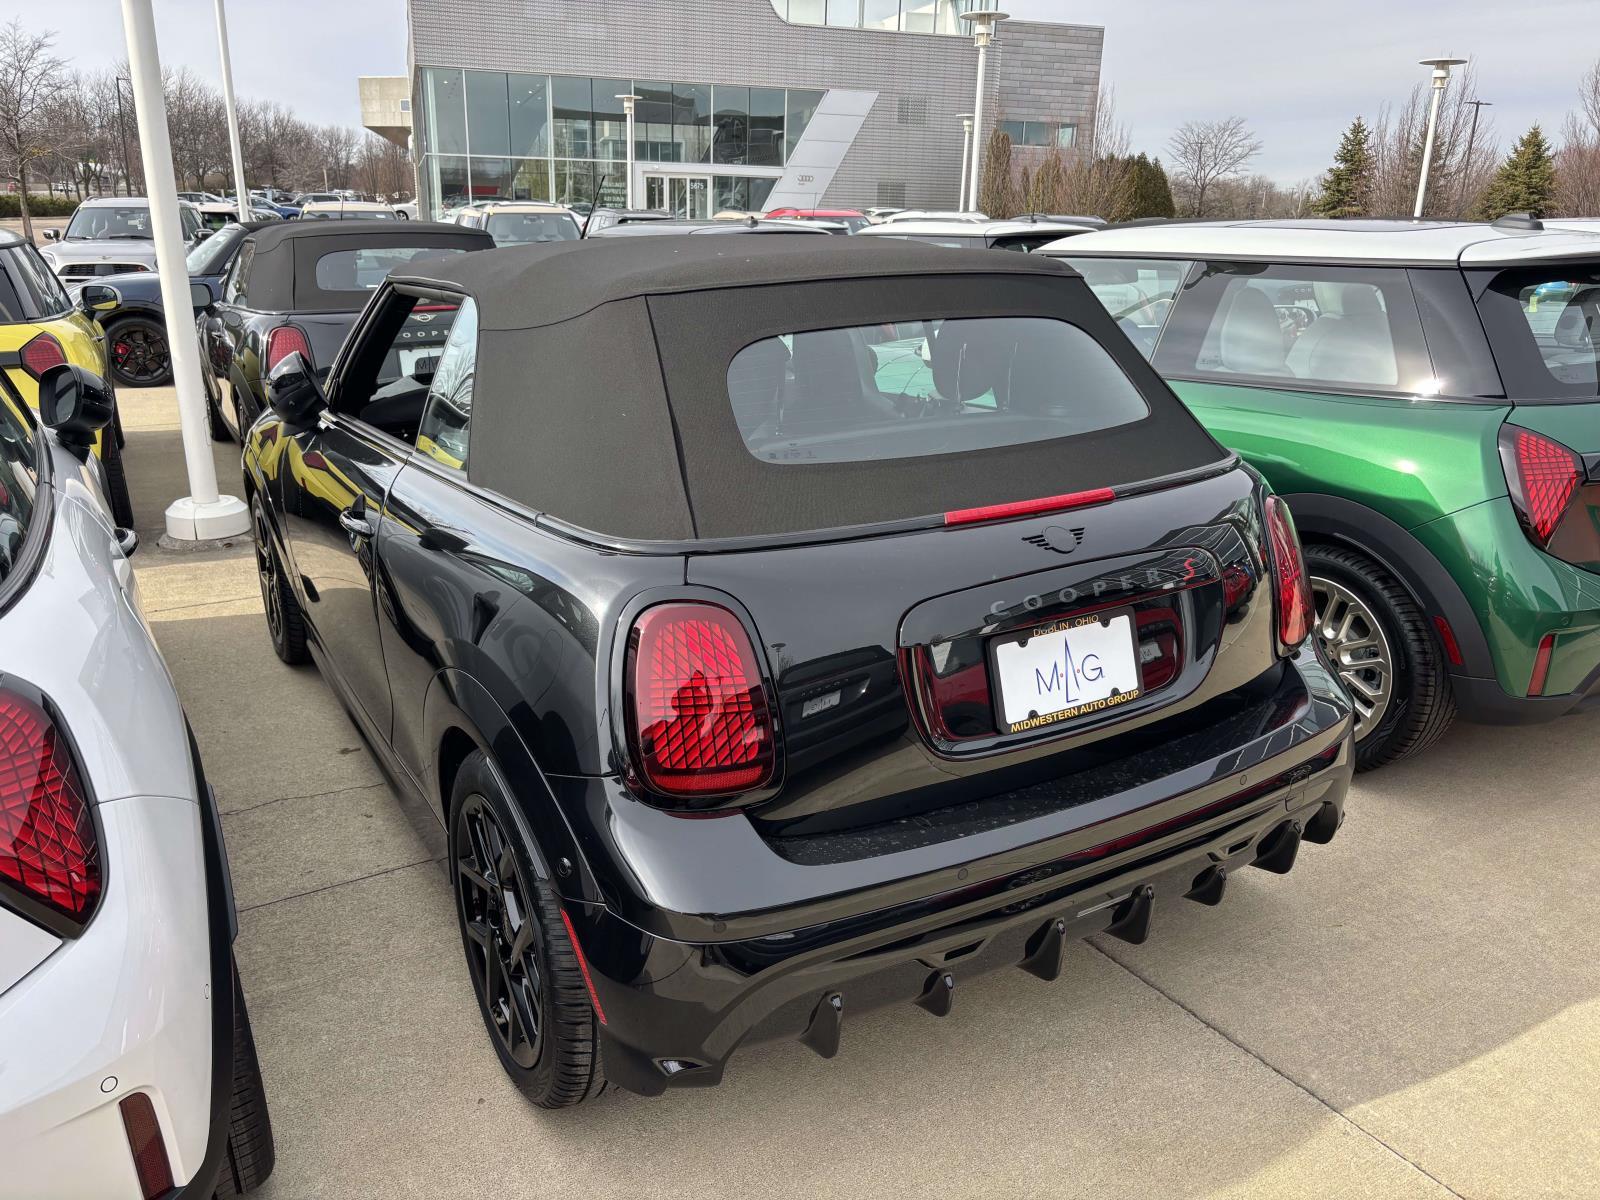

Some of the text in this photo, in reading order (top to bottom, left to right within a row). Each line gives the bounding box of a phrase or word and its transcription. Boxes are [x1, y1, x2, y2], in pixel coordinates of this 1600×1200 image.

[690, 182, 704, 190] 5875
[990, 558, 1195, 616] COOPER S
[1075, 614, 1099, 627] OHIO
[1010, 689, 1139, 732] MIDWESTERN AUTO GROUP
